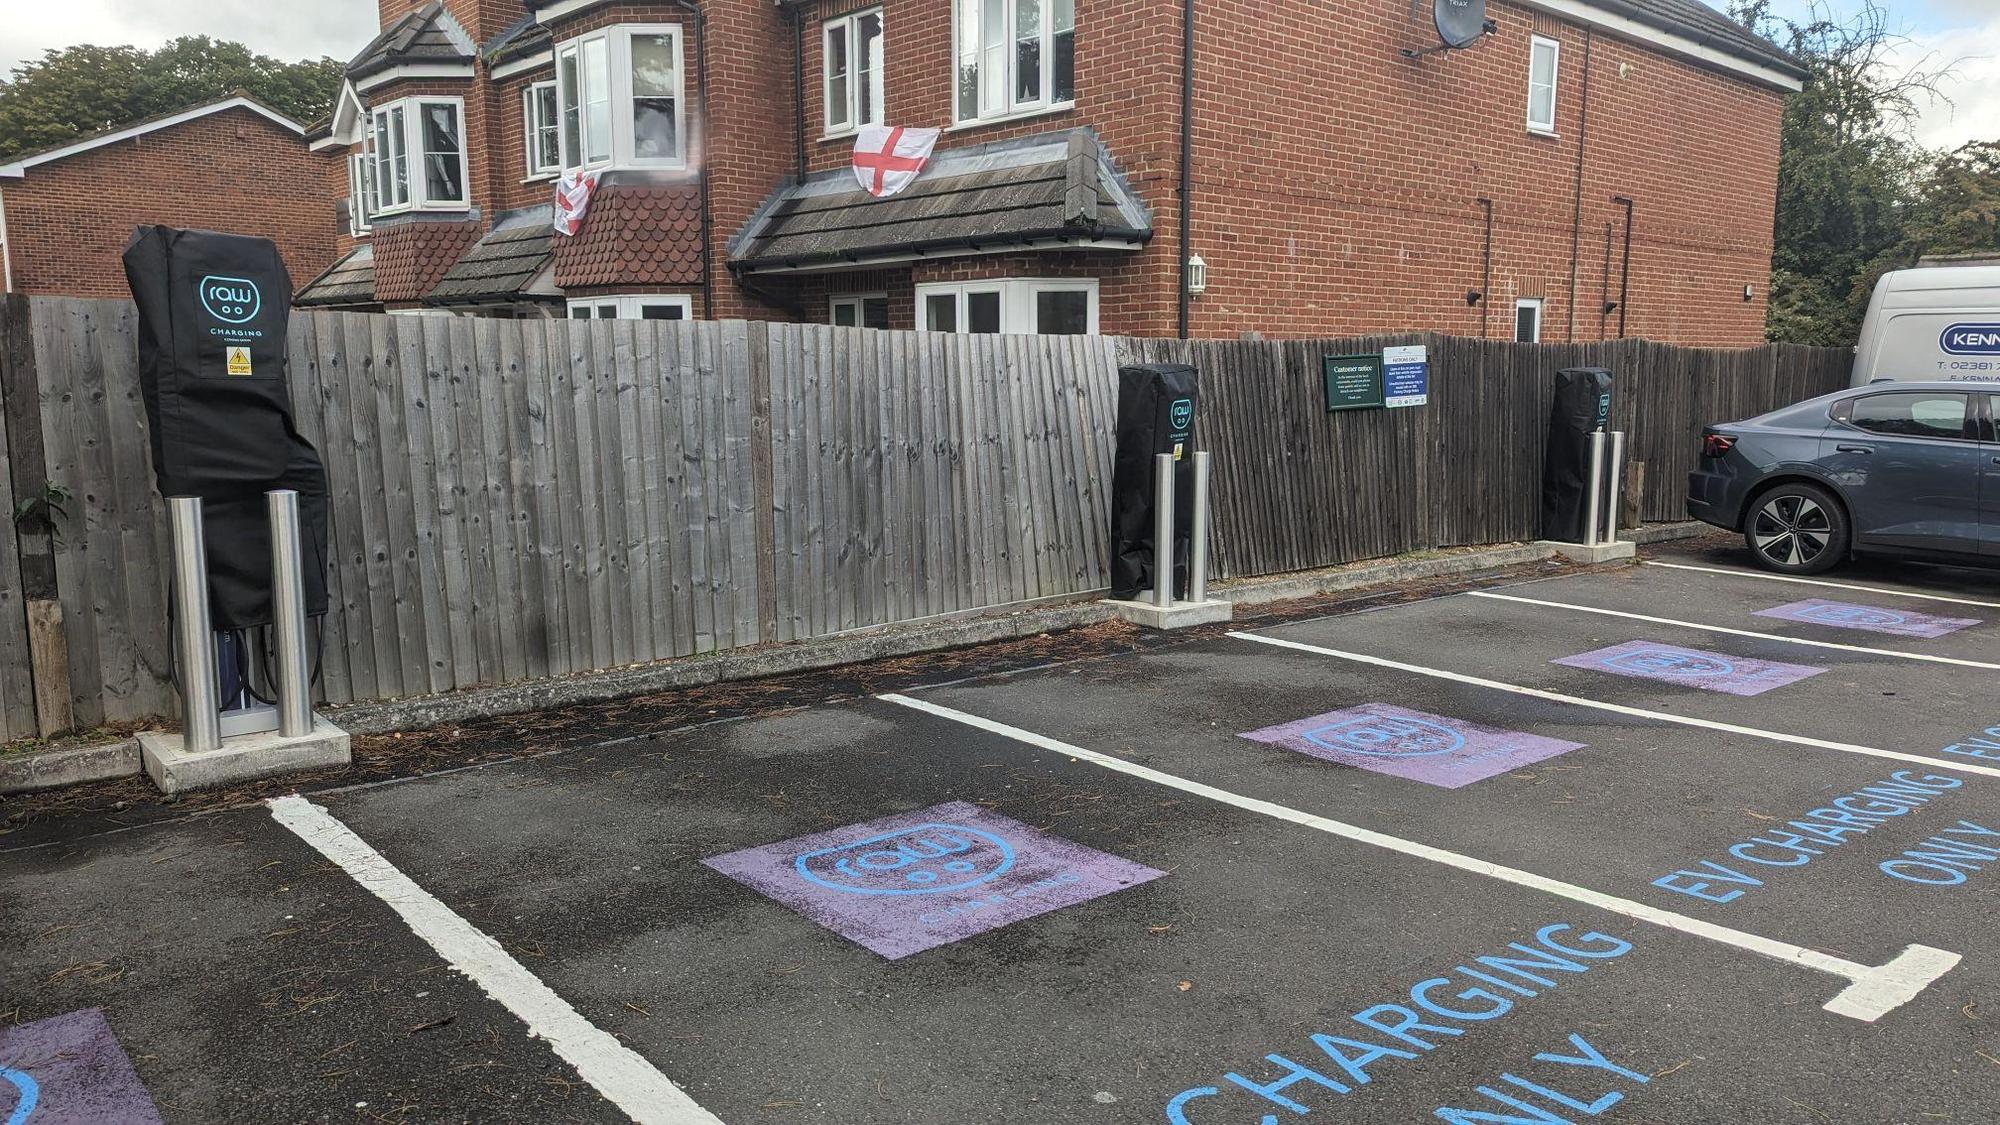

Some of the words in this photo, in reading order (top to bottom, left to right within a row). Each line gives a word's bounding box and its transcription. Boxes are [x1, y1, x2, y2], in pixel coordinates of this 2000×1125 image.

[210, 286, 252, 303] raw
[210, 327, 263, 337] CHARGING
[1651, 860, 1764, 904] EV
[1728, 771, 1963, 866] CHARGING
[1879, 819, 2000, 885] ONLY
